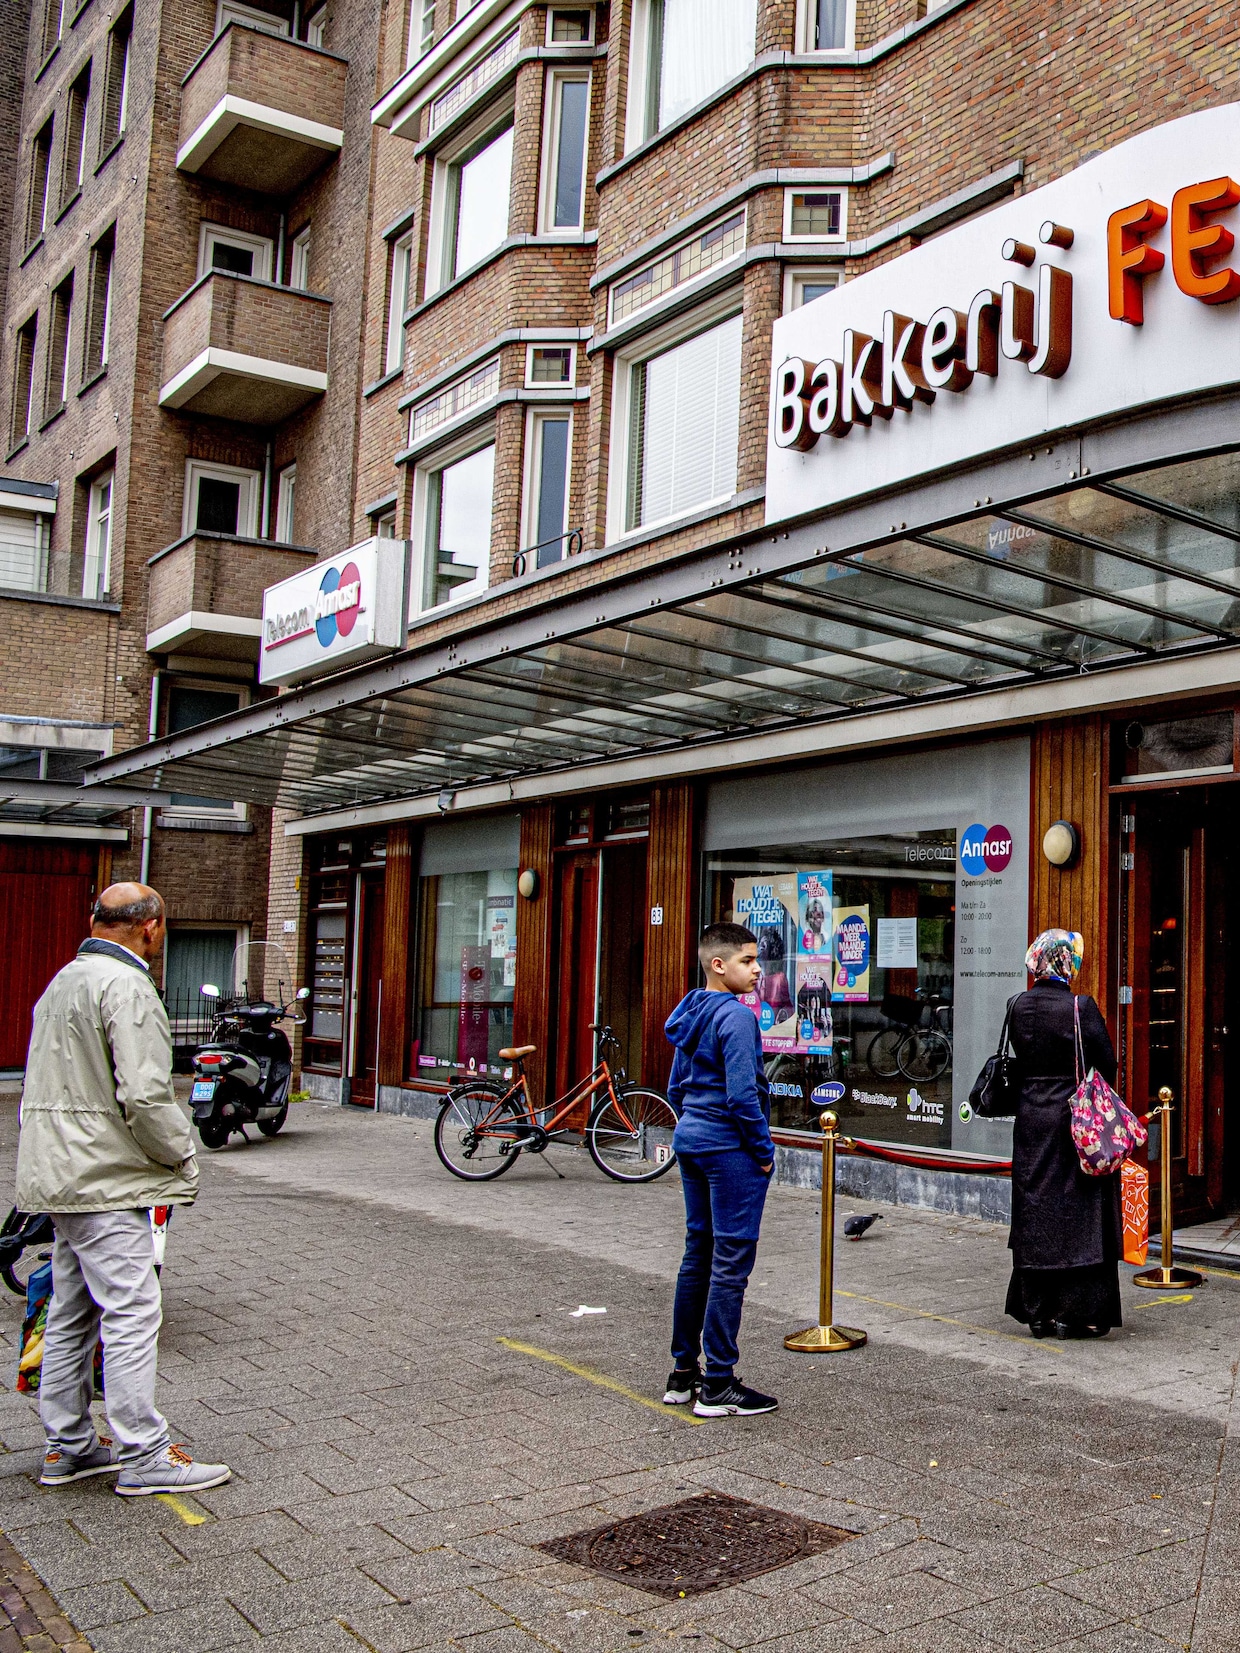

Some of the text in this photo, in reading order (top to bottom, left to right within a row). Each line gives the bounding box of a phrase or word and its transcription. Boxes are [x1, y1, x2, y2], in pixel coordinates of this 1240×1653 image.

[774, 221, 1075, 452] Bakkerij
[266, 580, 361, 643] Telecom Annasr
[904, 838, 1012, 862] Telecom Annasr
[961, 878, 1002, 887] Openingstijden
[752, 885, 774, 898] WAT
[652, 909, 661, 922] 83
[752, 910, 785, 923] TEGEN?
[960, 970, 1023, 978] www.telecom-annasr.nl
[762, 1009, 772, 1019] €10
[768, 1082, 803, 1098] NOKIA
[813, 1087, 840, 1100] SAMSUNG
[660, 1149, 665, 1162] B
